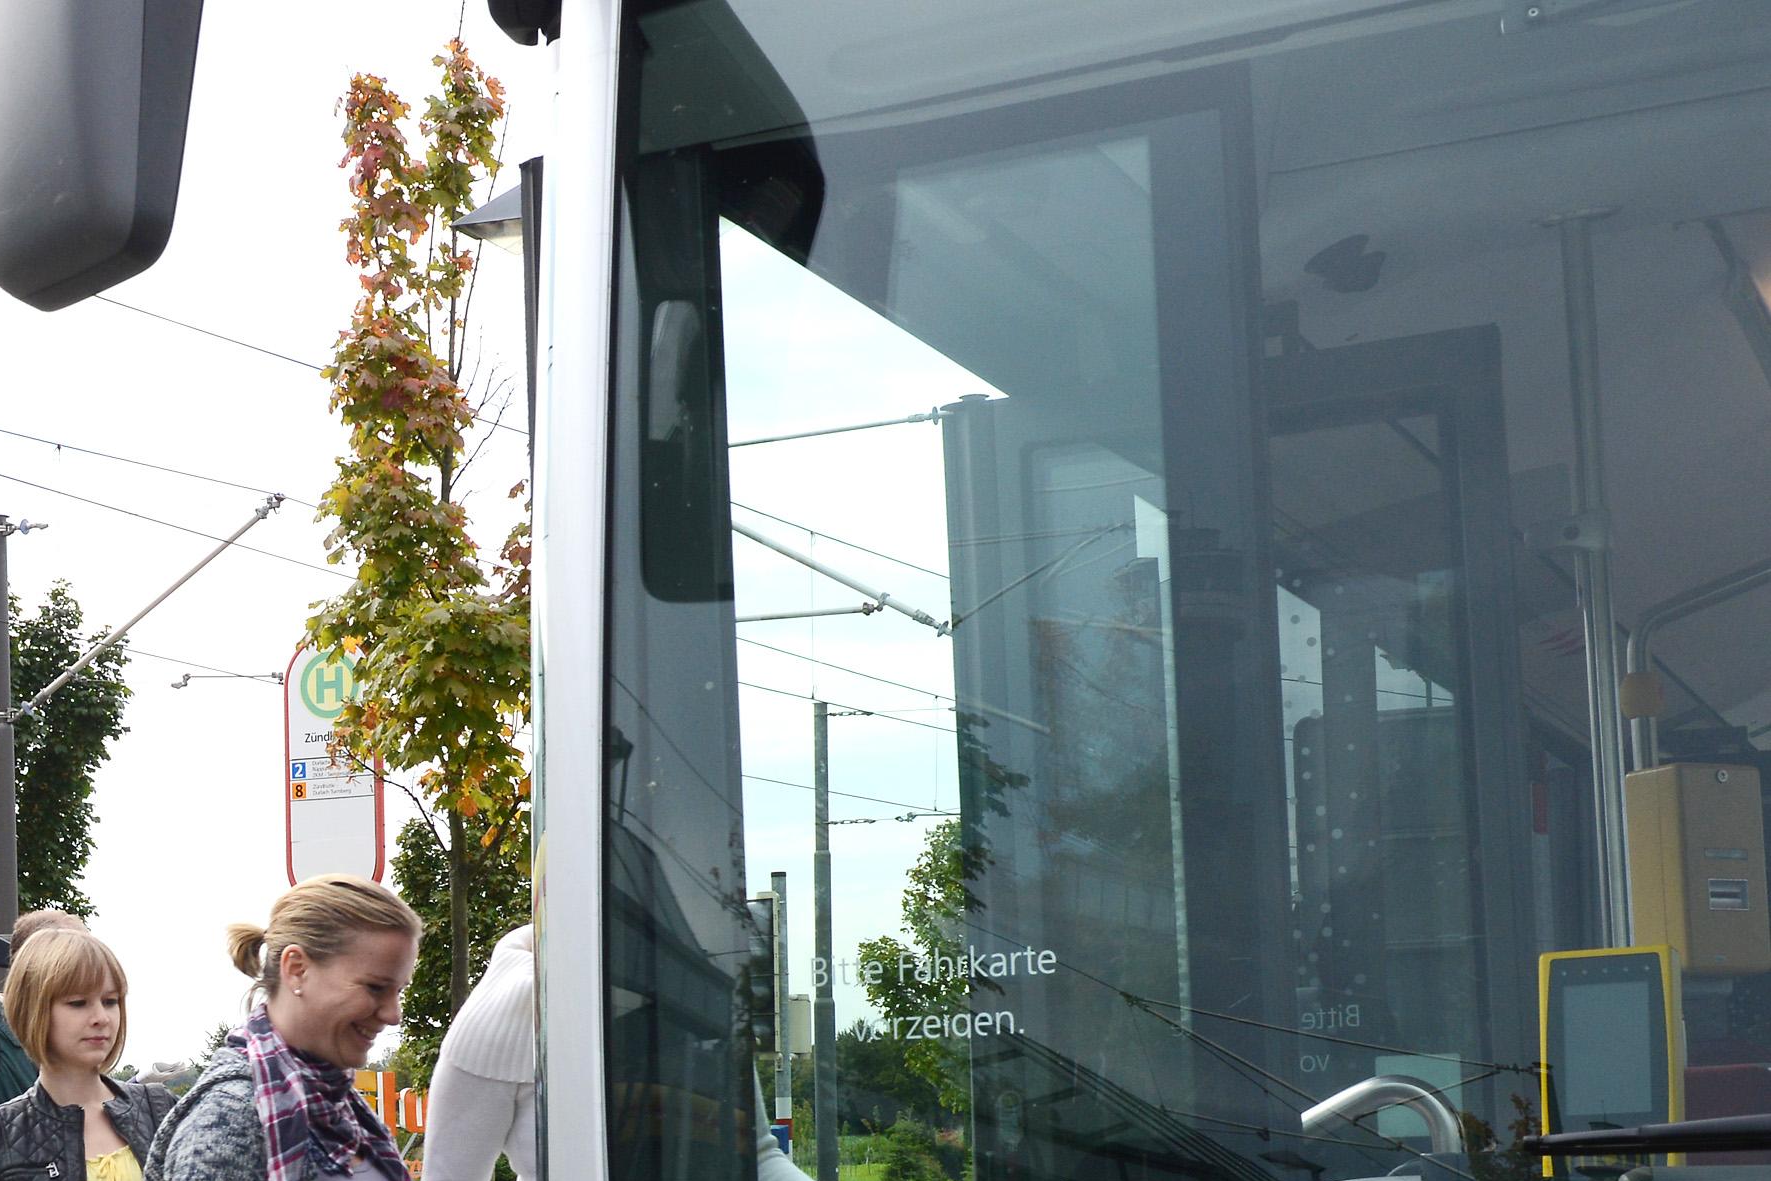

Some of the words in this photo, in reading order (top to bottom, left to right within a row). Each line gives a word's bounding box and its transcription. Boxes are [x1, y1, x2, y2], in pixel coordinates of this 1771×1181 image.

[304, 731, 333, 743] Zünd
[294, 763, 304, 778] 2
[295, 784, 304, 798] 8
[810, 955, 884, 988] Bitte
[898, 945, 1057, 984] Fahrkarte
